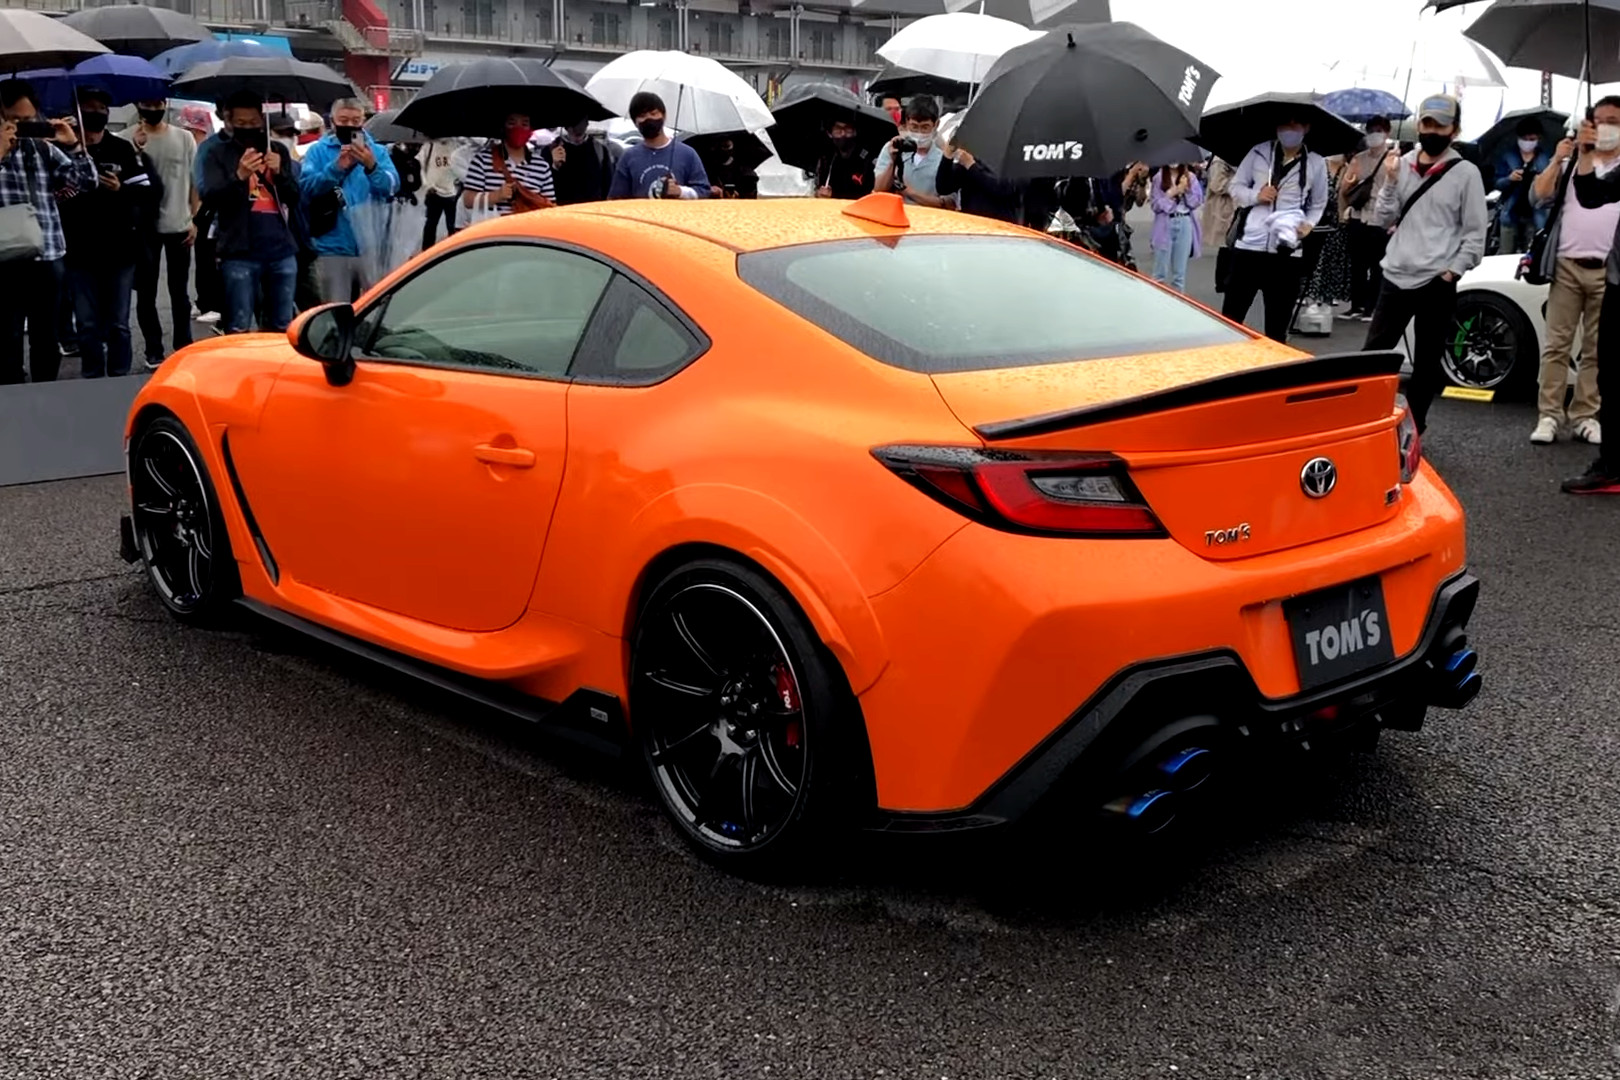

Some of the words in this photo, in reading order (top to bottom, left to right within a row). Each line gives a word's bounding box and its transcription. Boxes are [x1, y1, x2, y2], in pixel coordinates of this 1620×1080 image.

[1178, 65, 1200, 106] TOM'S
[1023, 141, 1083, 161] TOM'S
[1205, 523, 1250, 546] TOM'S
[1305, 608, 1381, 665] TOM'S
